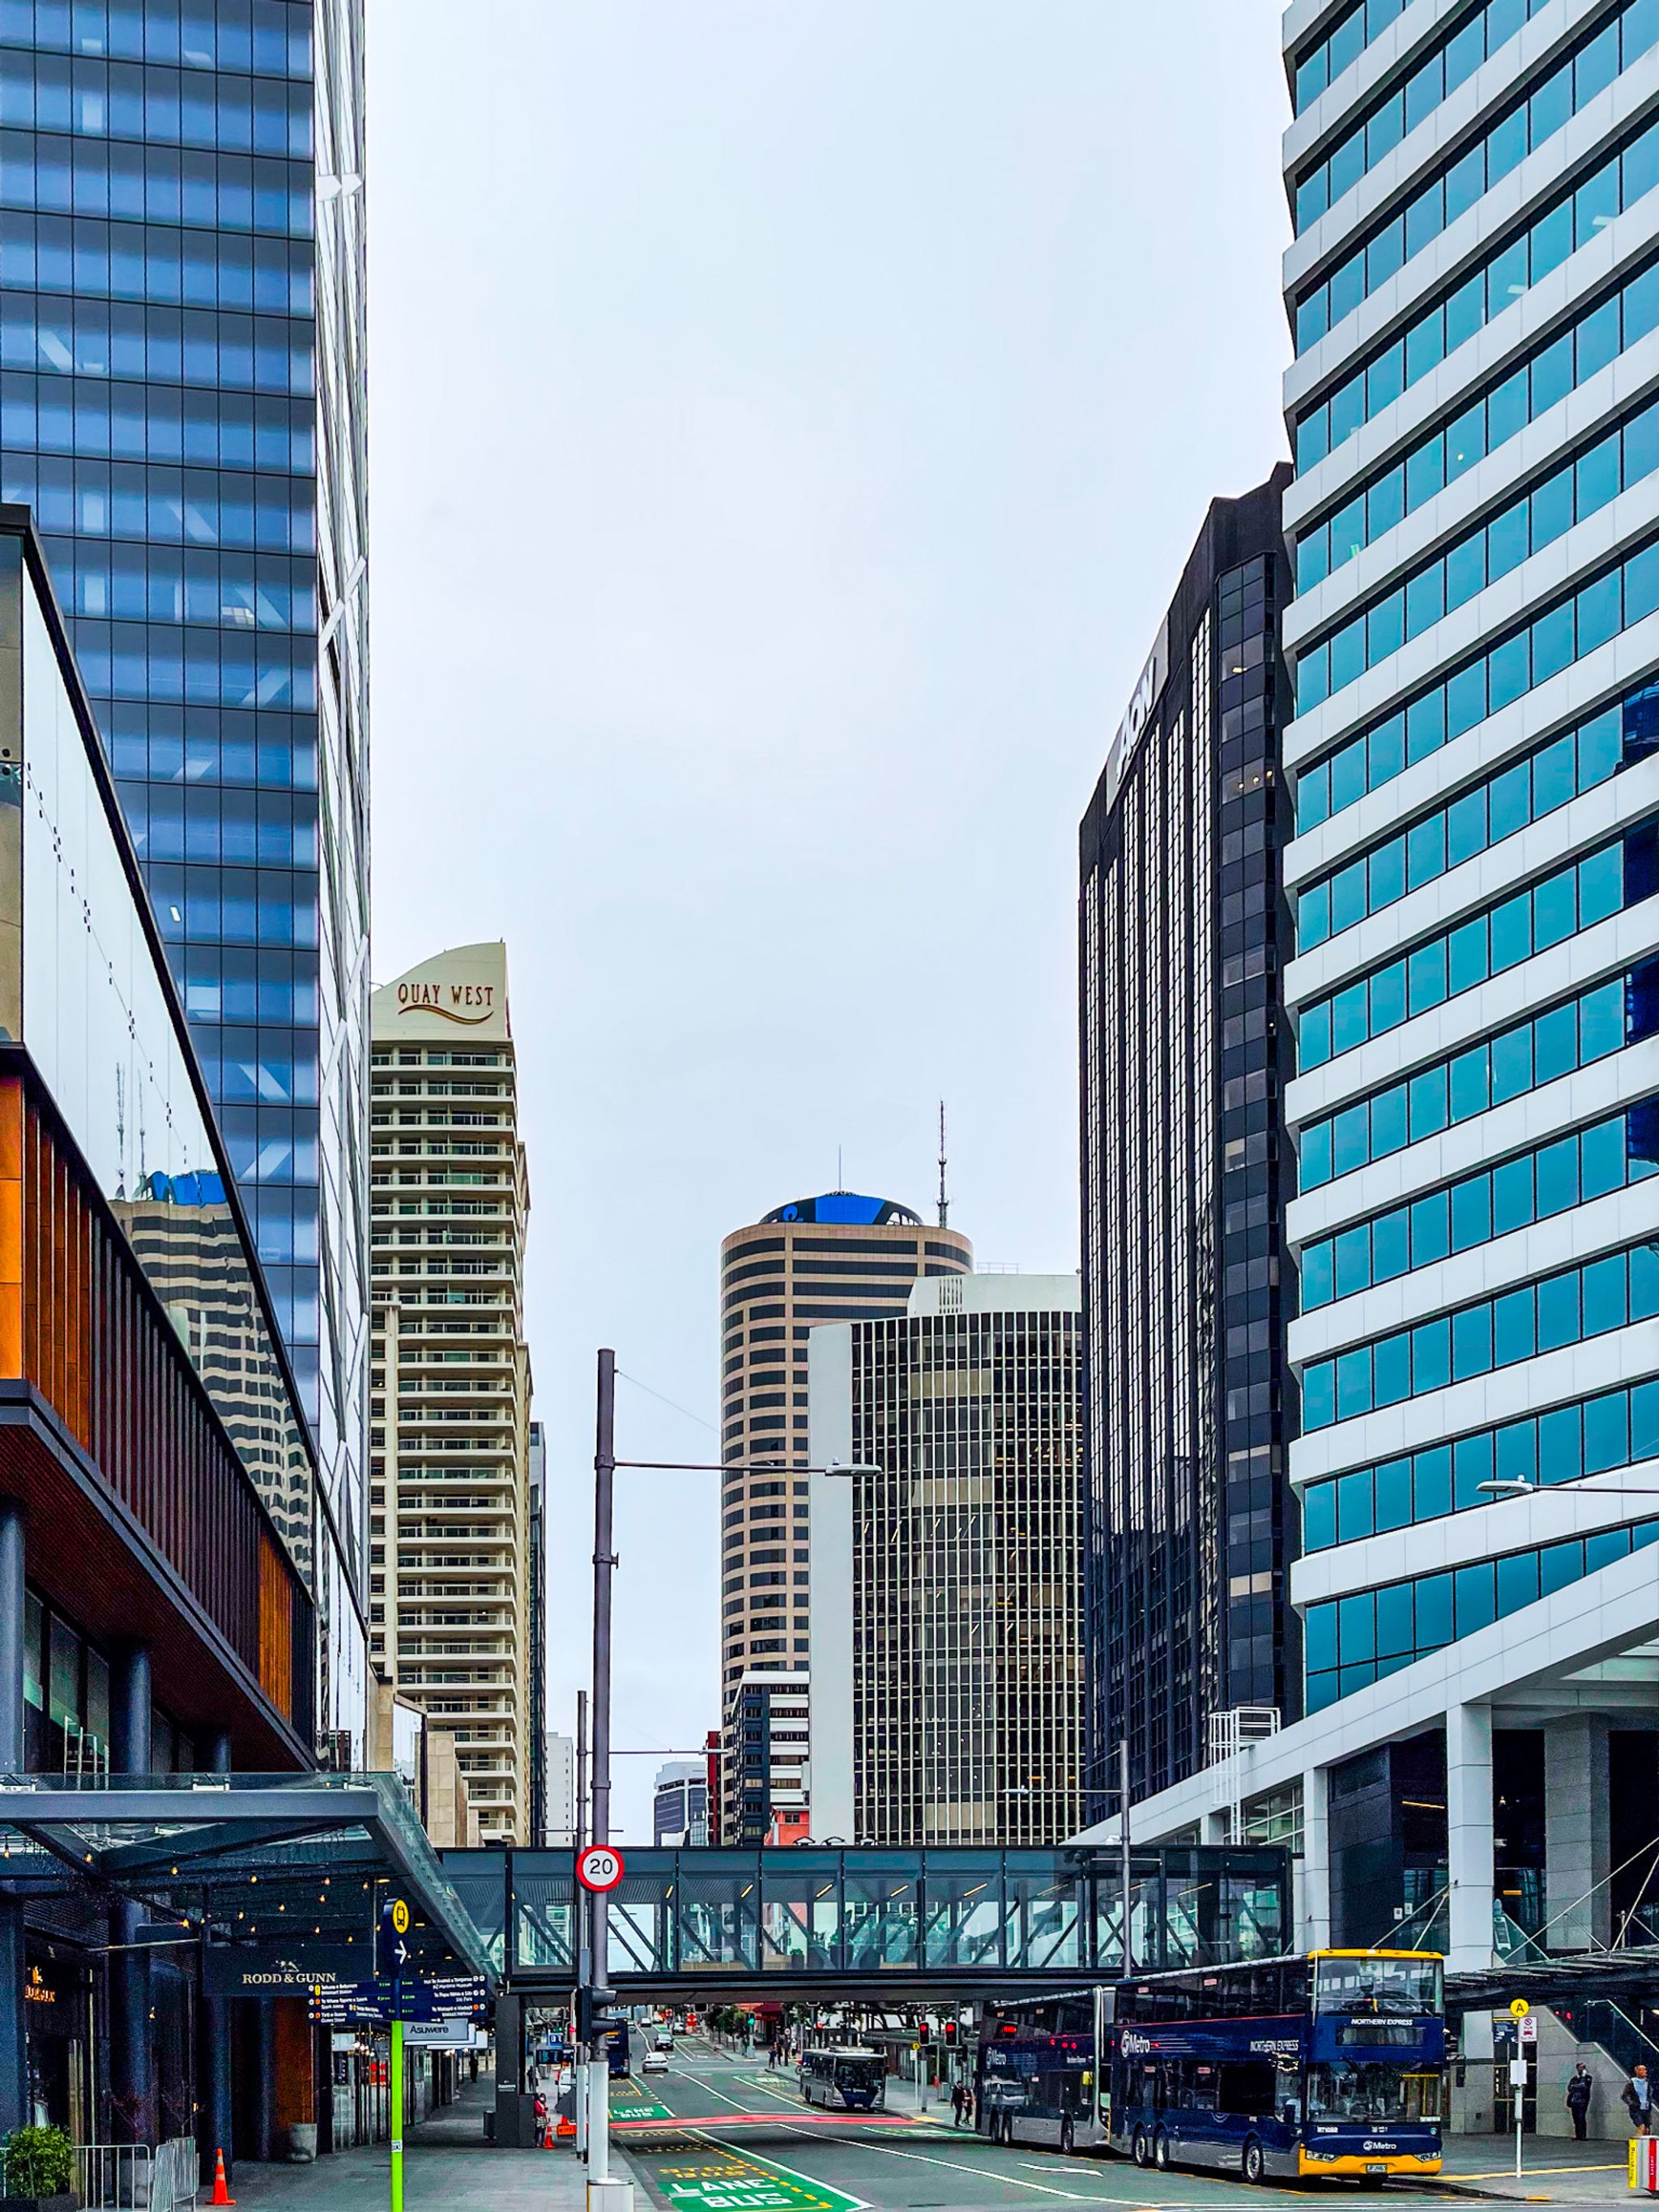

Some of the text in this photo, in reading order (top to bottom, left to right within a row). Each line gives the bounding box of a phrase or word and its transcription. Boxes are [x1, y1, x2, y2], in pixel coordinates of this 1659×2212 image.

[1116, 657, 1156, 784] AON
[398, 983, 493, 1005] QUAY WEST
[590, 1858, 613, 1874] 20
[242, 1972, 337, 1984] RODD & GUNN
[1516, 2003, 1525, 2013] A
[1387, 2018, 1413, 2027] EXPRESS
[1130, 2034, 1150, 2053] Metro
[1373, 2142, 1397, 2150] Metro
[670, 2179, 776, 2196] LANE
[700, 2193, 793, 2208] BUS
